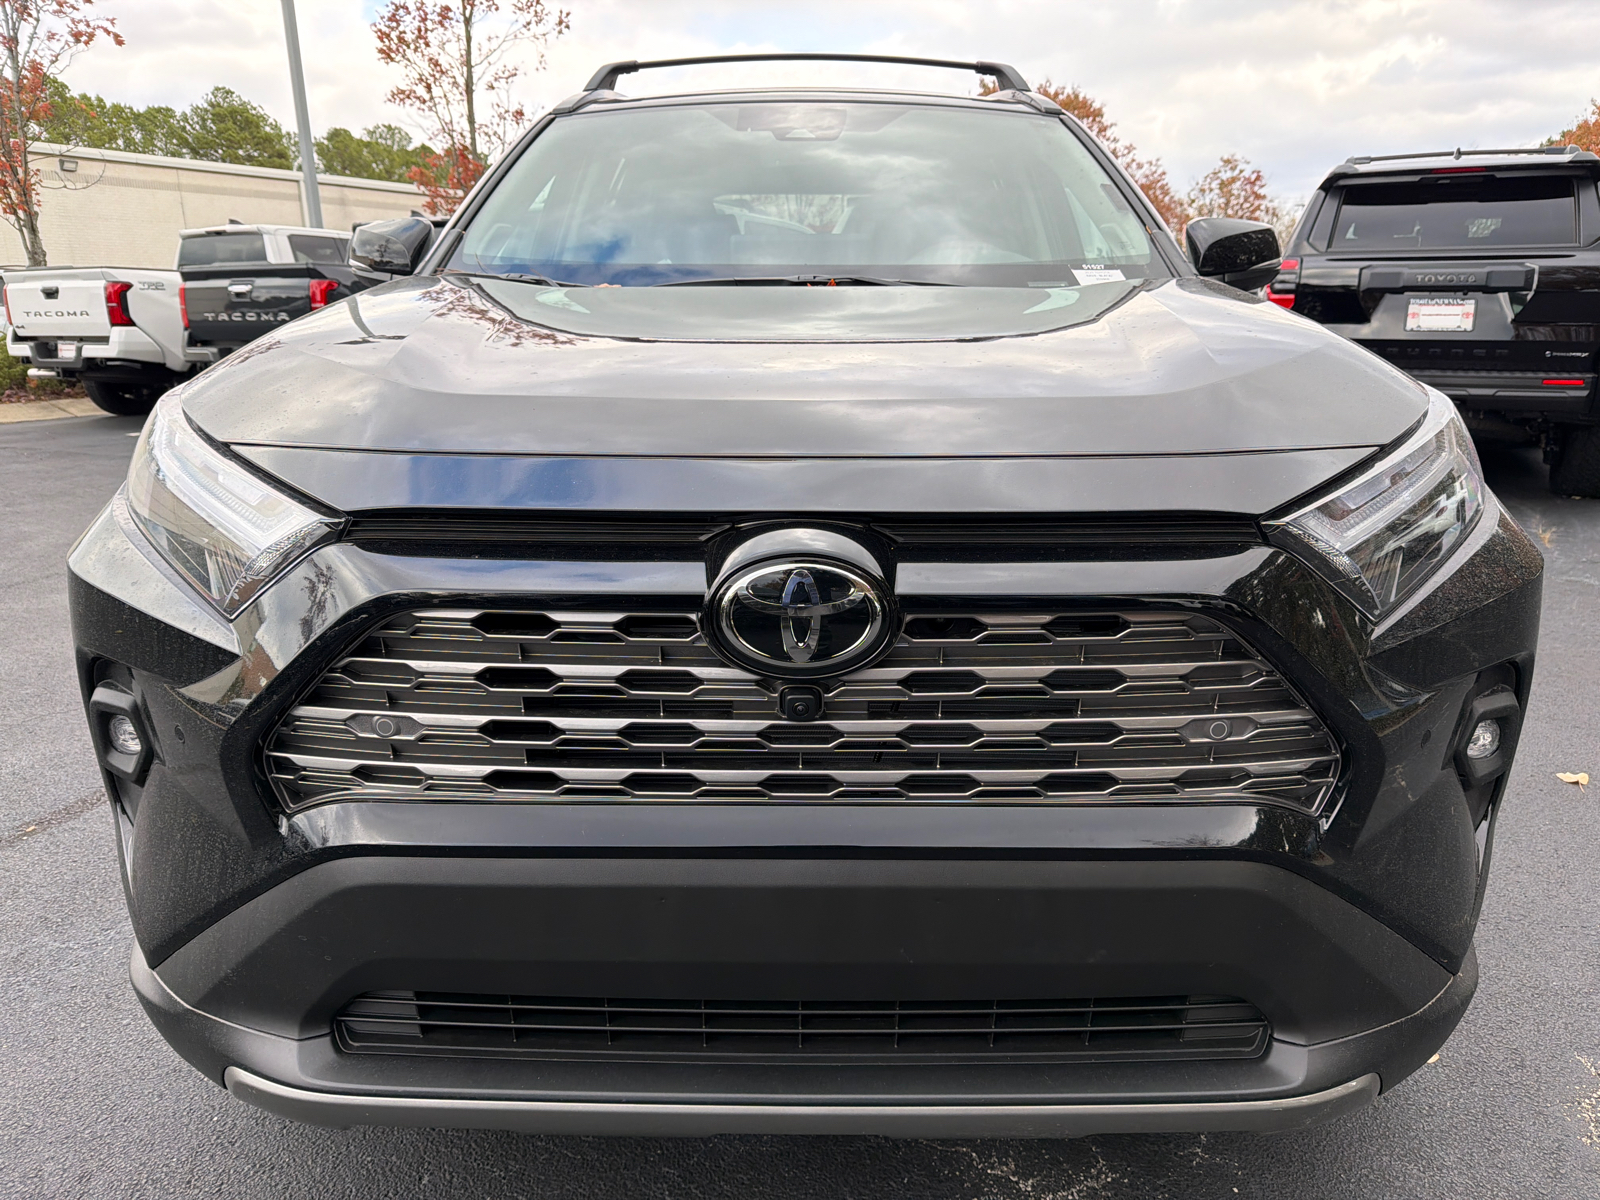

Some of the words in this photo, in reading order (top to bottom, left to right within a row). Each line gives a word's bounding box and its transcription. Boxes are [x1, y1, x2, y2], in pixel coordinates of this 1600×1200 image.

[1415, 274, 1476, 284] TOYOTA
[137, 280, 166, 291] TRD
[23, 310, 90, 318] TACOMA
[203, 311, 291, 322] TACOMA
